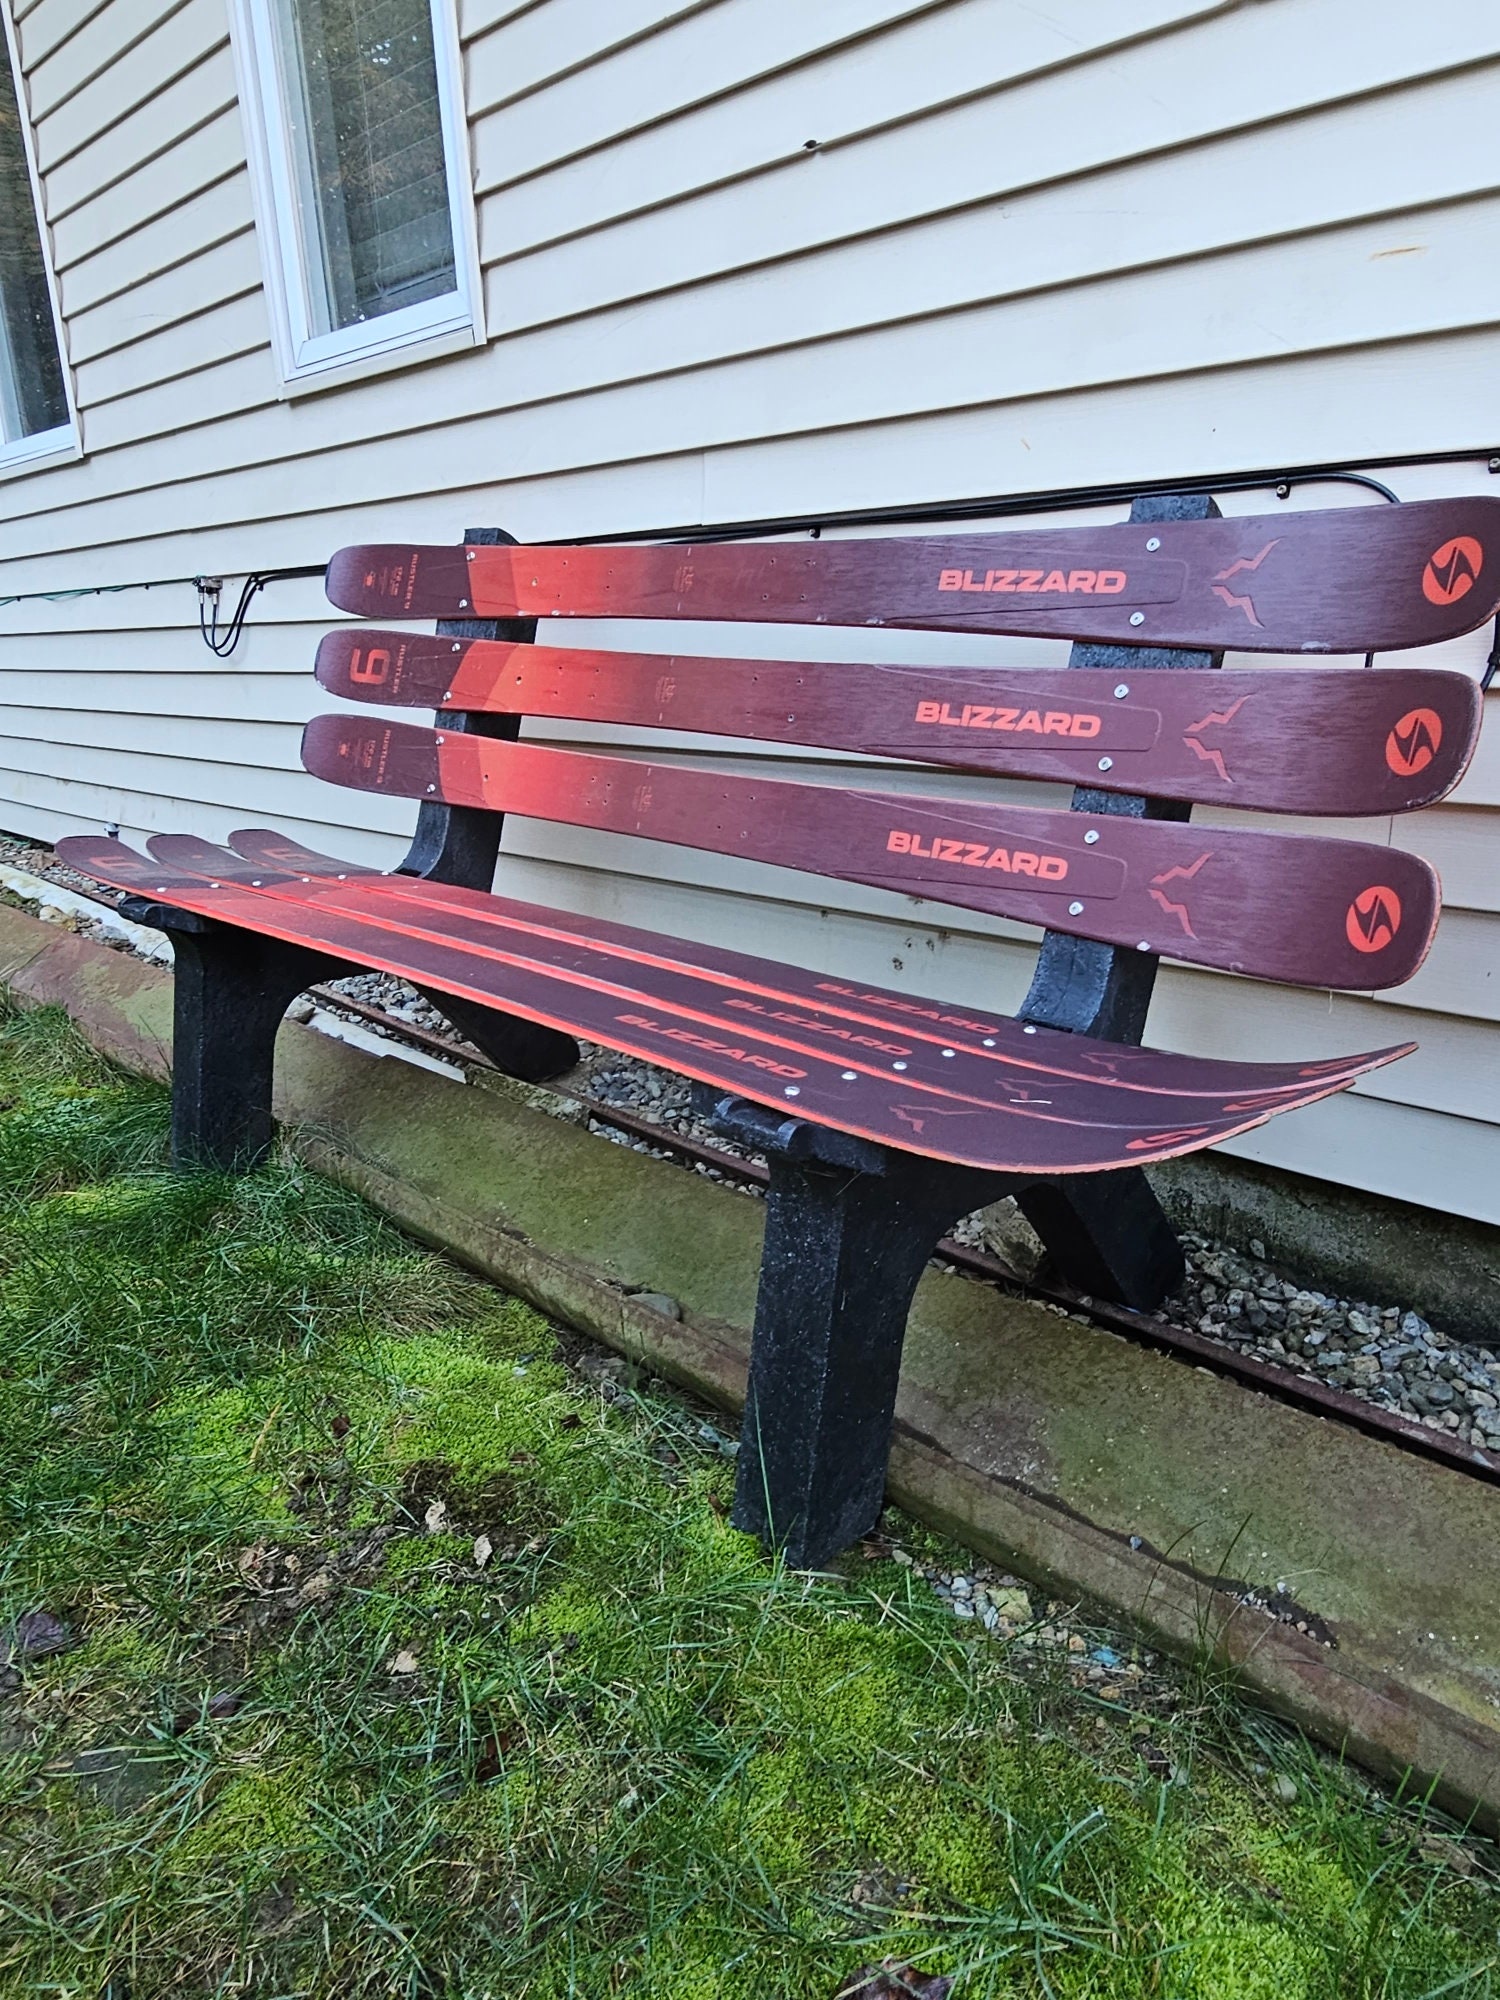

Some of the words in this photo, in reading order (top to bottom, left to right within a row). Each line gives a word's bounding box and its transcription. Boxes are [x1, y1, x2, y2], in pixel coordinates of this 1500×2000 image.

[939, 570, 1127, 594] BLIZZARD
[350, 648, 390, 685] 9
[915, 699, 1102, 739] BLIZZARD
[886, 829, 1069, 881] BLIZZARD
[722, 998, 913, 1058] BLIZZARD
[814, 981, 1000, 1035] BLIZZARD
[614, 1013, 808, 1080] BLIZZARD
